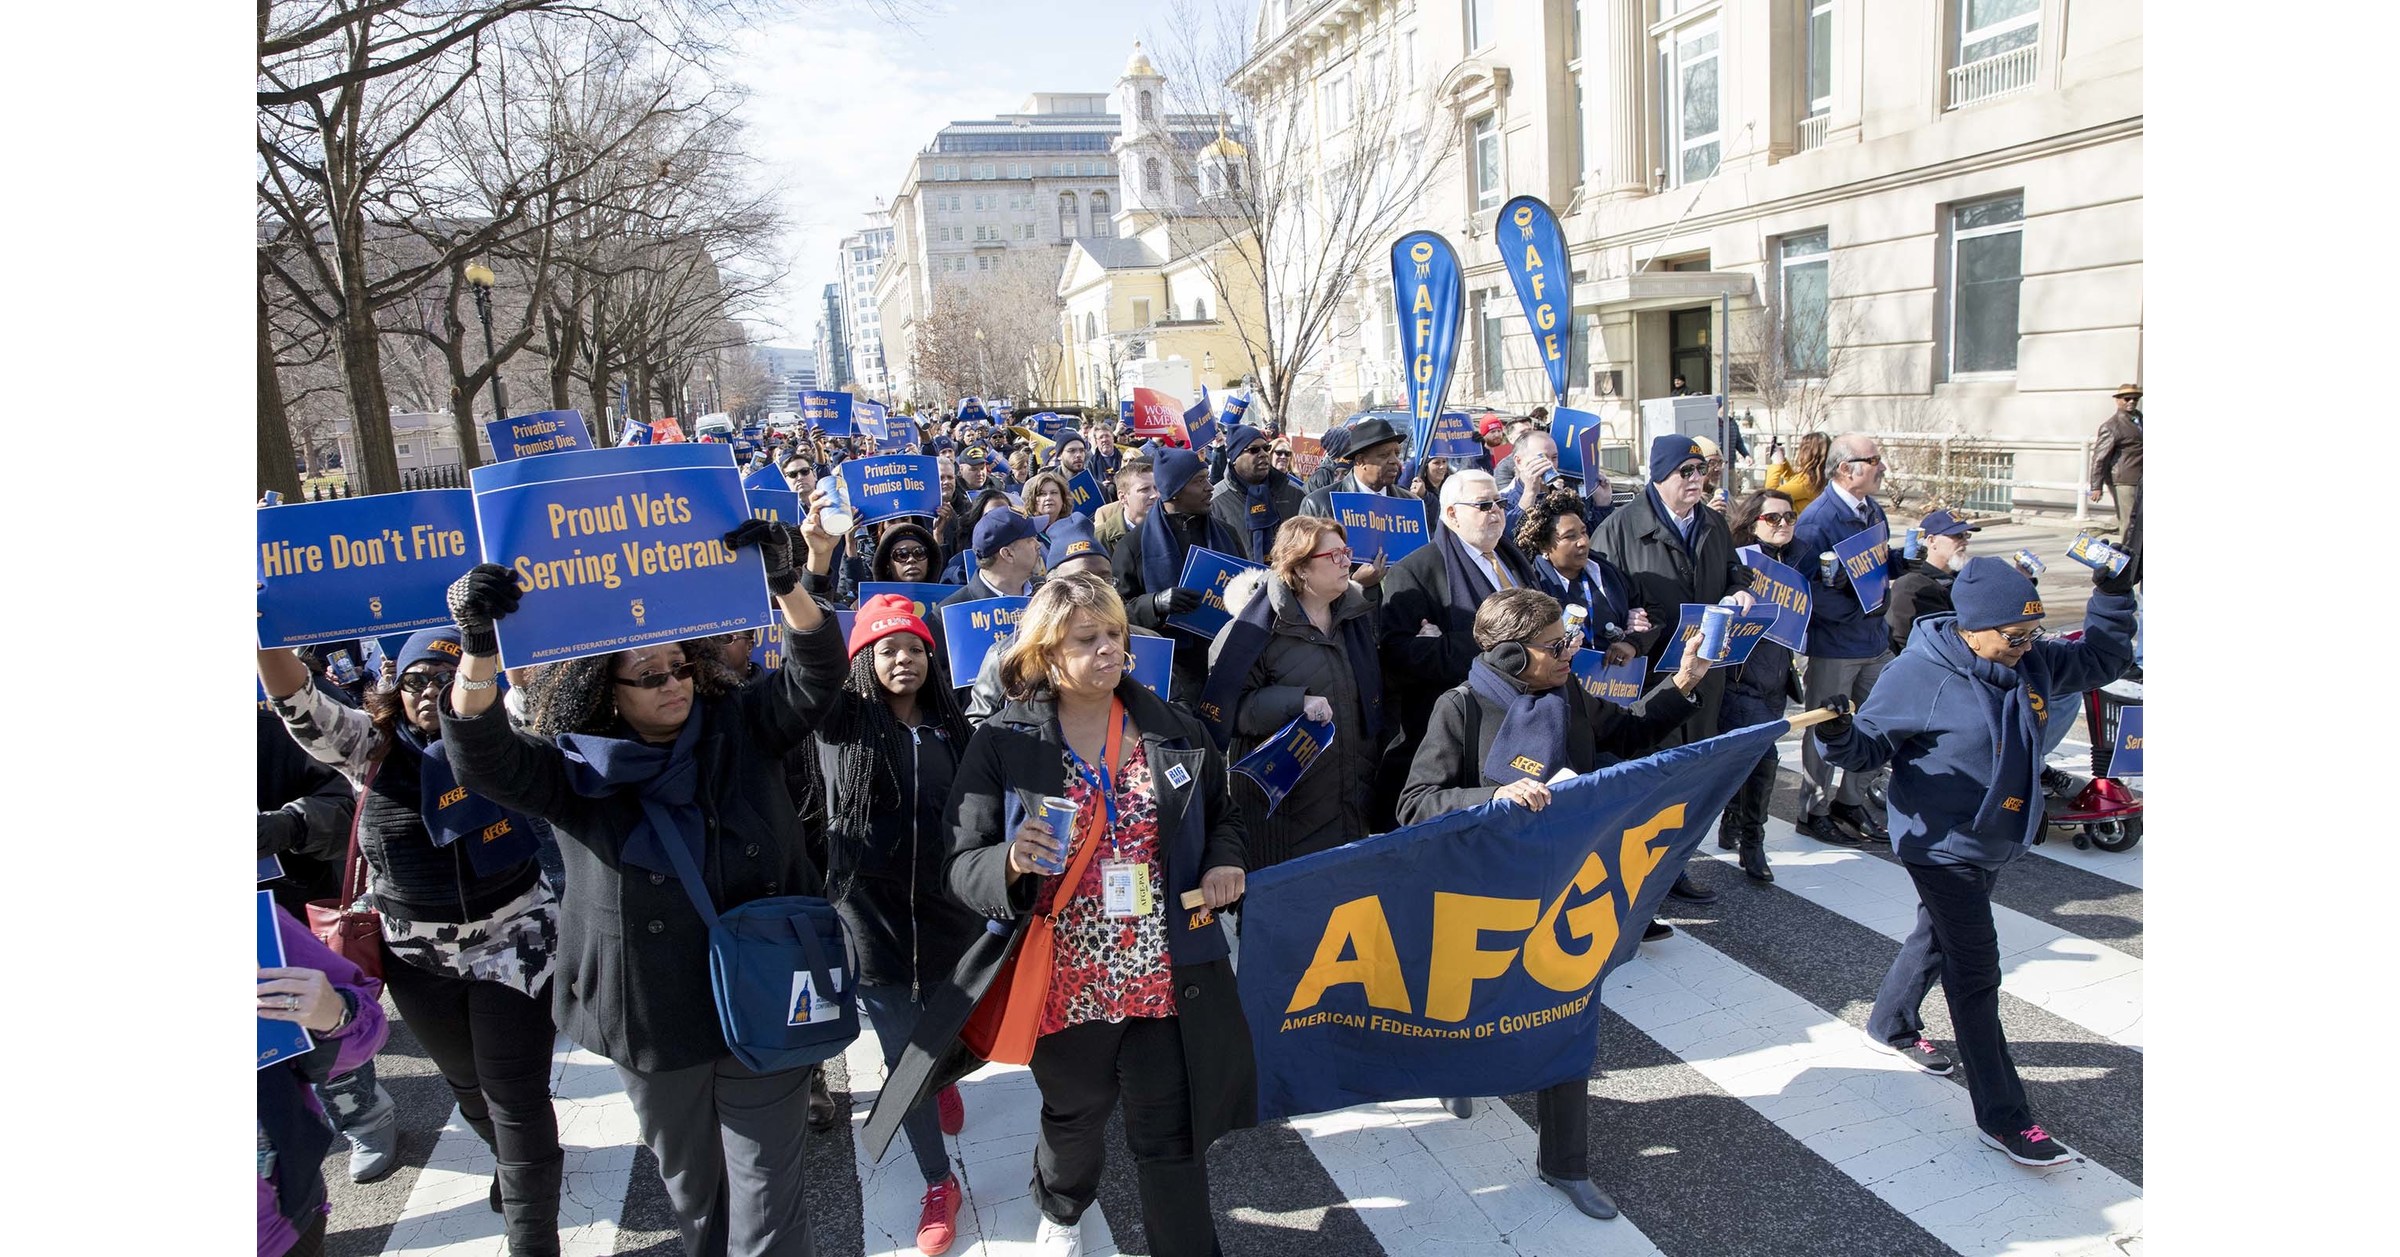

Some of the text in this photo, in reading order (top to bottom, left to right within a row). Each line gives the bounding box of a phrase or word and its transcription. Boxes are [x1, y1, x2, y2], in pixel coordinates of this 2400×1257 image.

[1525, 245, 1561, 361] AFGE
[1412, 284, 1434, 419] AFGE
[512, 420, 557, 440] Privatize
[513, 435, 577, 458] Promise Dies
[864, 462, 908, 479] Privatize
[863, 478, 926, 498] Promise Dies
[548, 493, 692, 539] Proud Vets
[1342, 509, 1420, 534] Hire Don't Fire
[261, 524, 466, 578] Hire Don't Fire
[1066, 541, 1091, 557] AFGE
[514, 538, 738, 593] Serving Veterans
[1847, 550, 1875, 579] STAFF
[1749, 567, 1809, 616] STAFF THE VA
[2022, 601, 2045, 616] AFG
[283, 633, 318, 643] AMERICAN
[318, 628, 358, 639] FEDERATION
[368, 621, 412, 633] GOVERNMENT
[971, 611, 991, 632] My
[1740, 624, 1764, 637] Fire
[427, 640, 463, 658] AFGE
[532, 617, 747, 659] AMERICAN FEDERATION OF GOVERNMENT EMPLOYEES, AFL-CIO
[1584, 675, 1608, 696] Love
[1608, 678, 1640, 698] Veterans
[1168, 765, 1184, 779] BIG
[1509, 755, 1545, 777] AFGE
[438, 786, 470, 811] AFGE
[2002, 796, 2024, 813] AFGE
[482, 818, 513, 845] AFGE
[1280, 1011, 1366, 1033] AMERICAN
[1370, 1015, 1471, 1040] FEDERATION
[1475, 1022, 1495, 1039] OF
